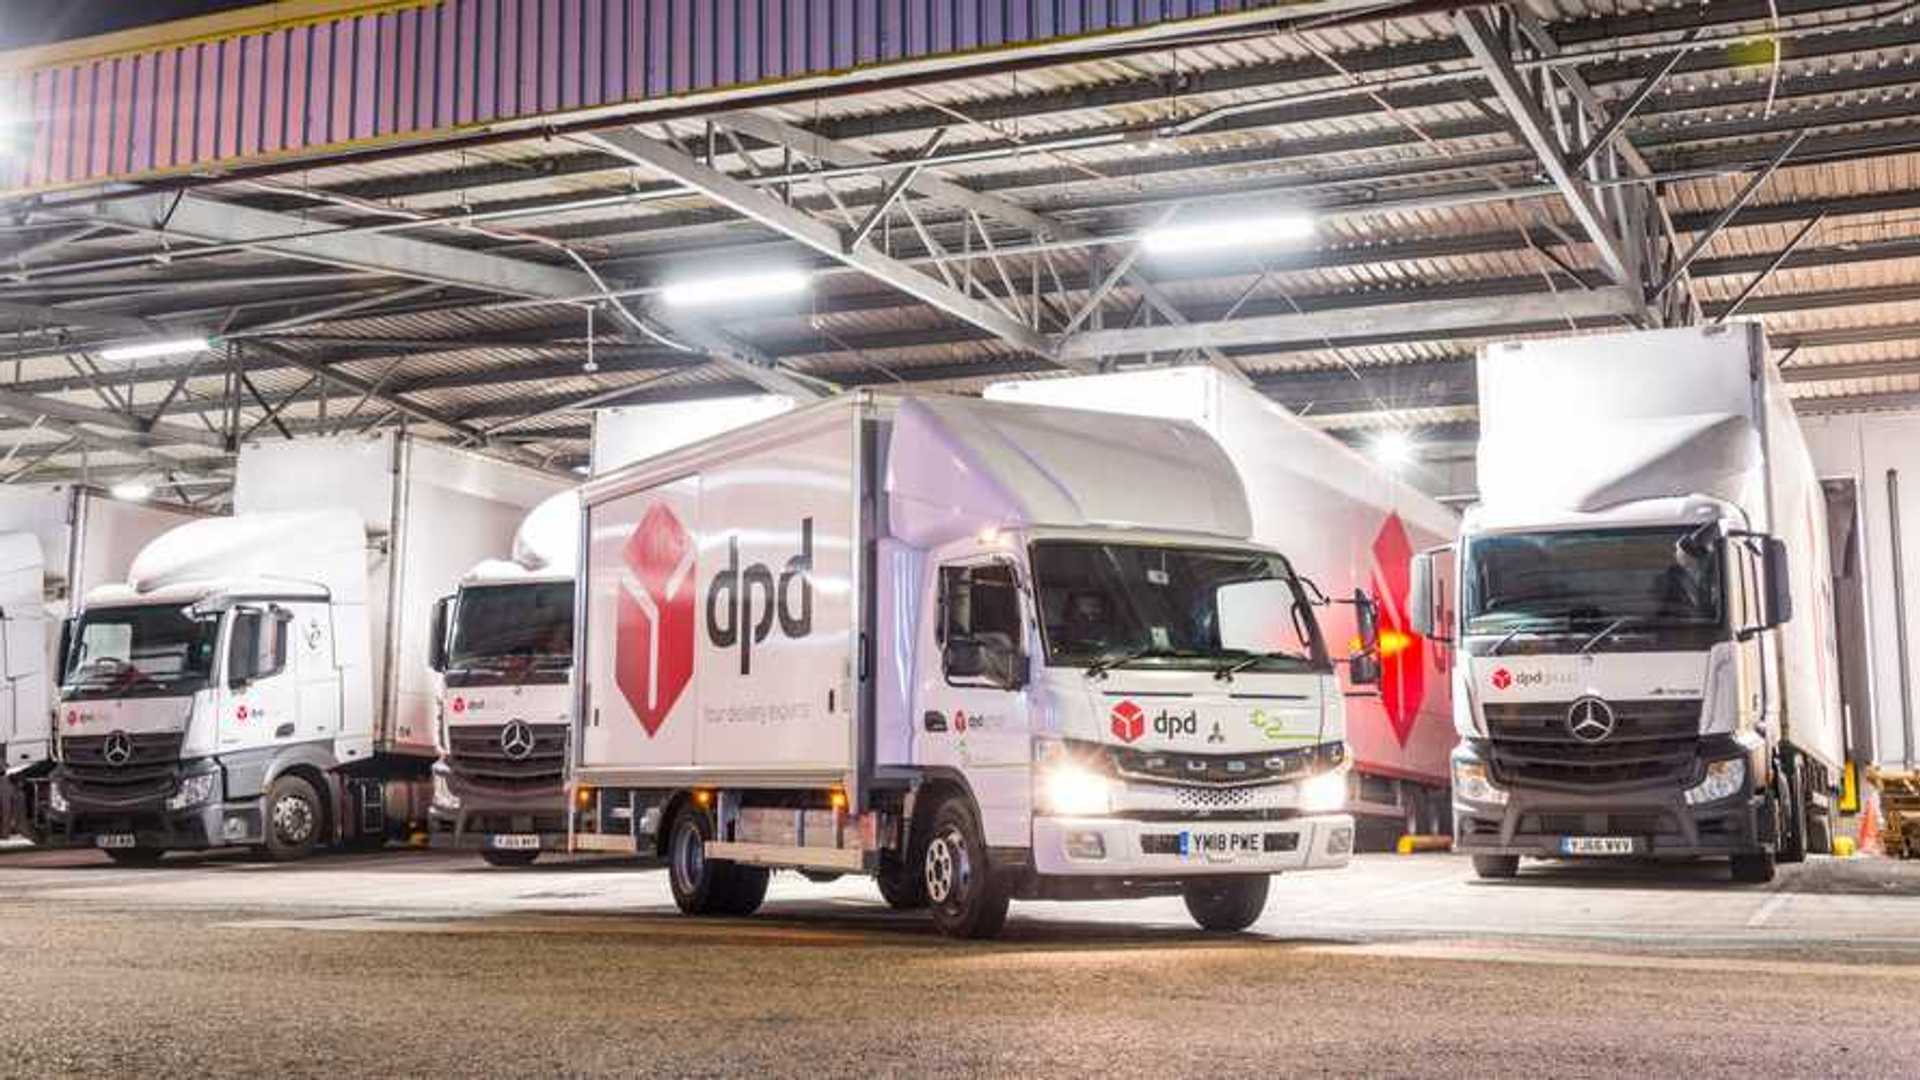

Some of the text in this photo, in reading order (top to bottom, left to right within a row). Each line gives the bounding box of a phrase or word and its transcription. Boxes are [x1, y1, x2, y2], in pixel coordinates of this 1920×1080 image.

[706, 517, 813, 675] dpd
[1154, 709, 1197, 740] dpd
[1231, 833, 1259, 849] PWE
